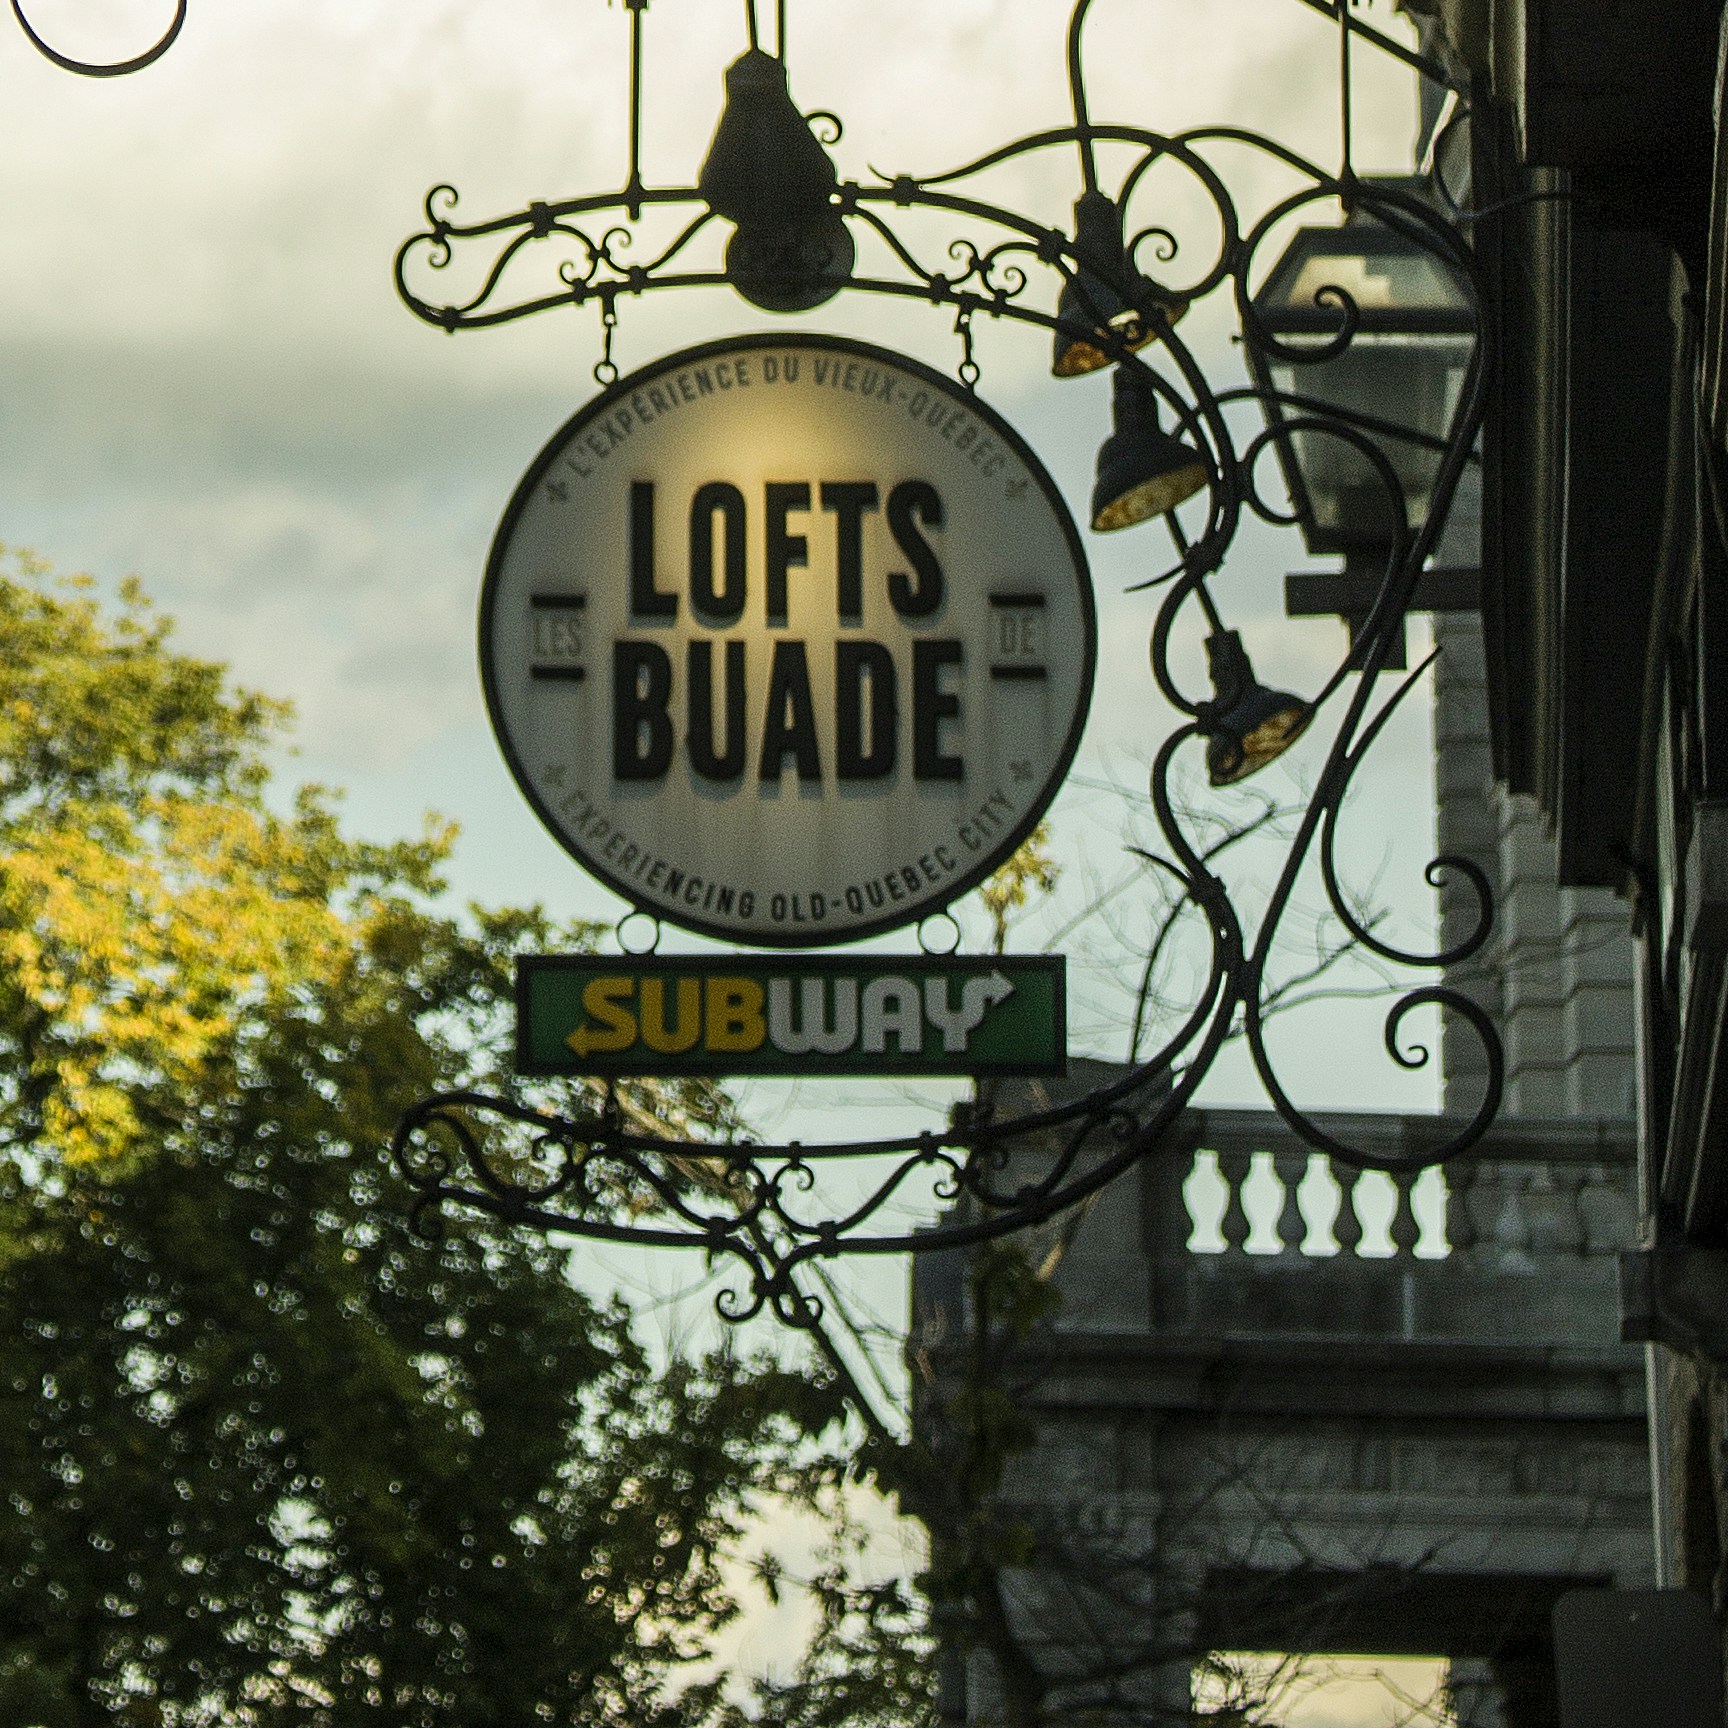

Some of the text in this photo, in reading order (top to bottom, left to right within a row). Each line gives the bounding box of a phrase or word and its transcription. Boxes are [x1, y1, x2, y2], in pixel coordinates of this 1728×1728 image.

[763, 354, 800, 384] DU
[627, 478, 948, 623] LOFTS
[611, 638, 966, 786] BUADE
[558, 789, 1017, 923] EXPERIENCING OLD-QUEBEC CITY
[564, 969, 1016, 1059] SUBWAY
